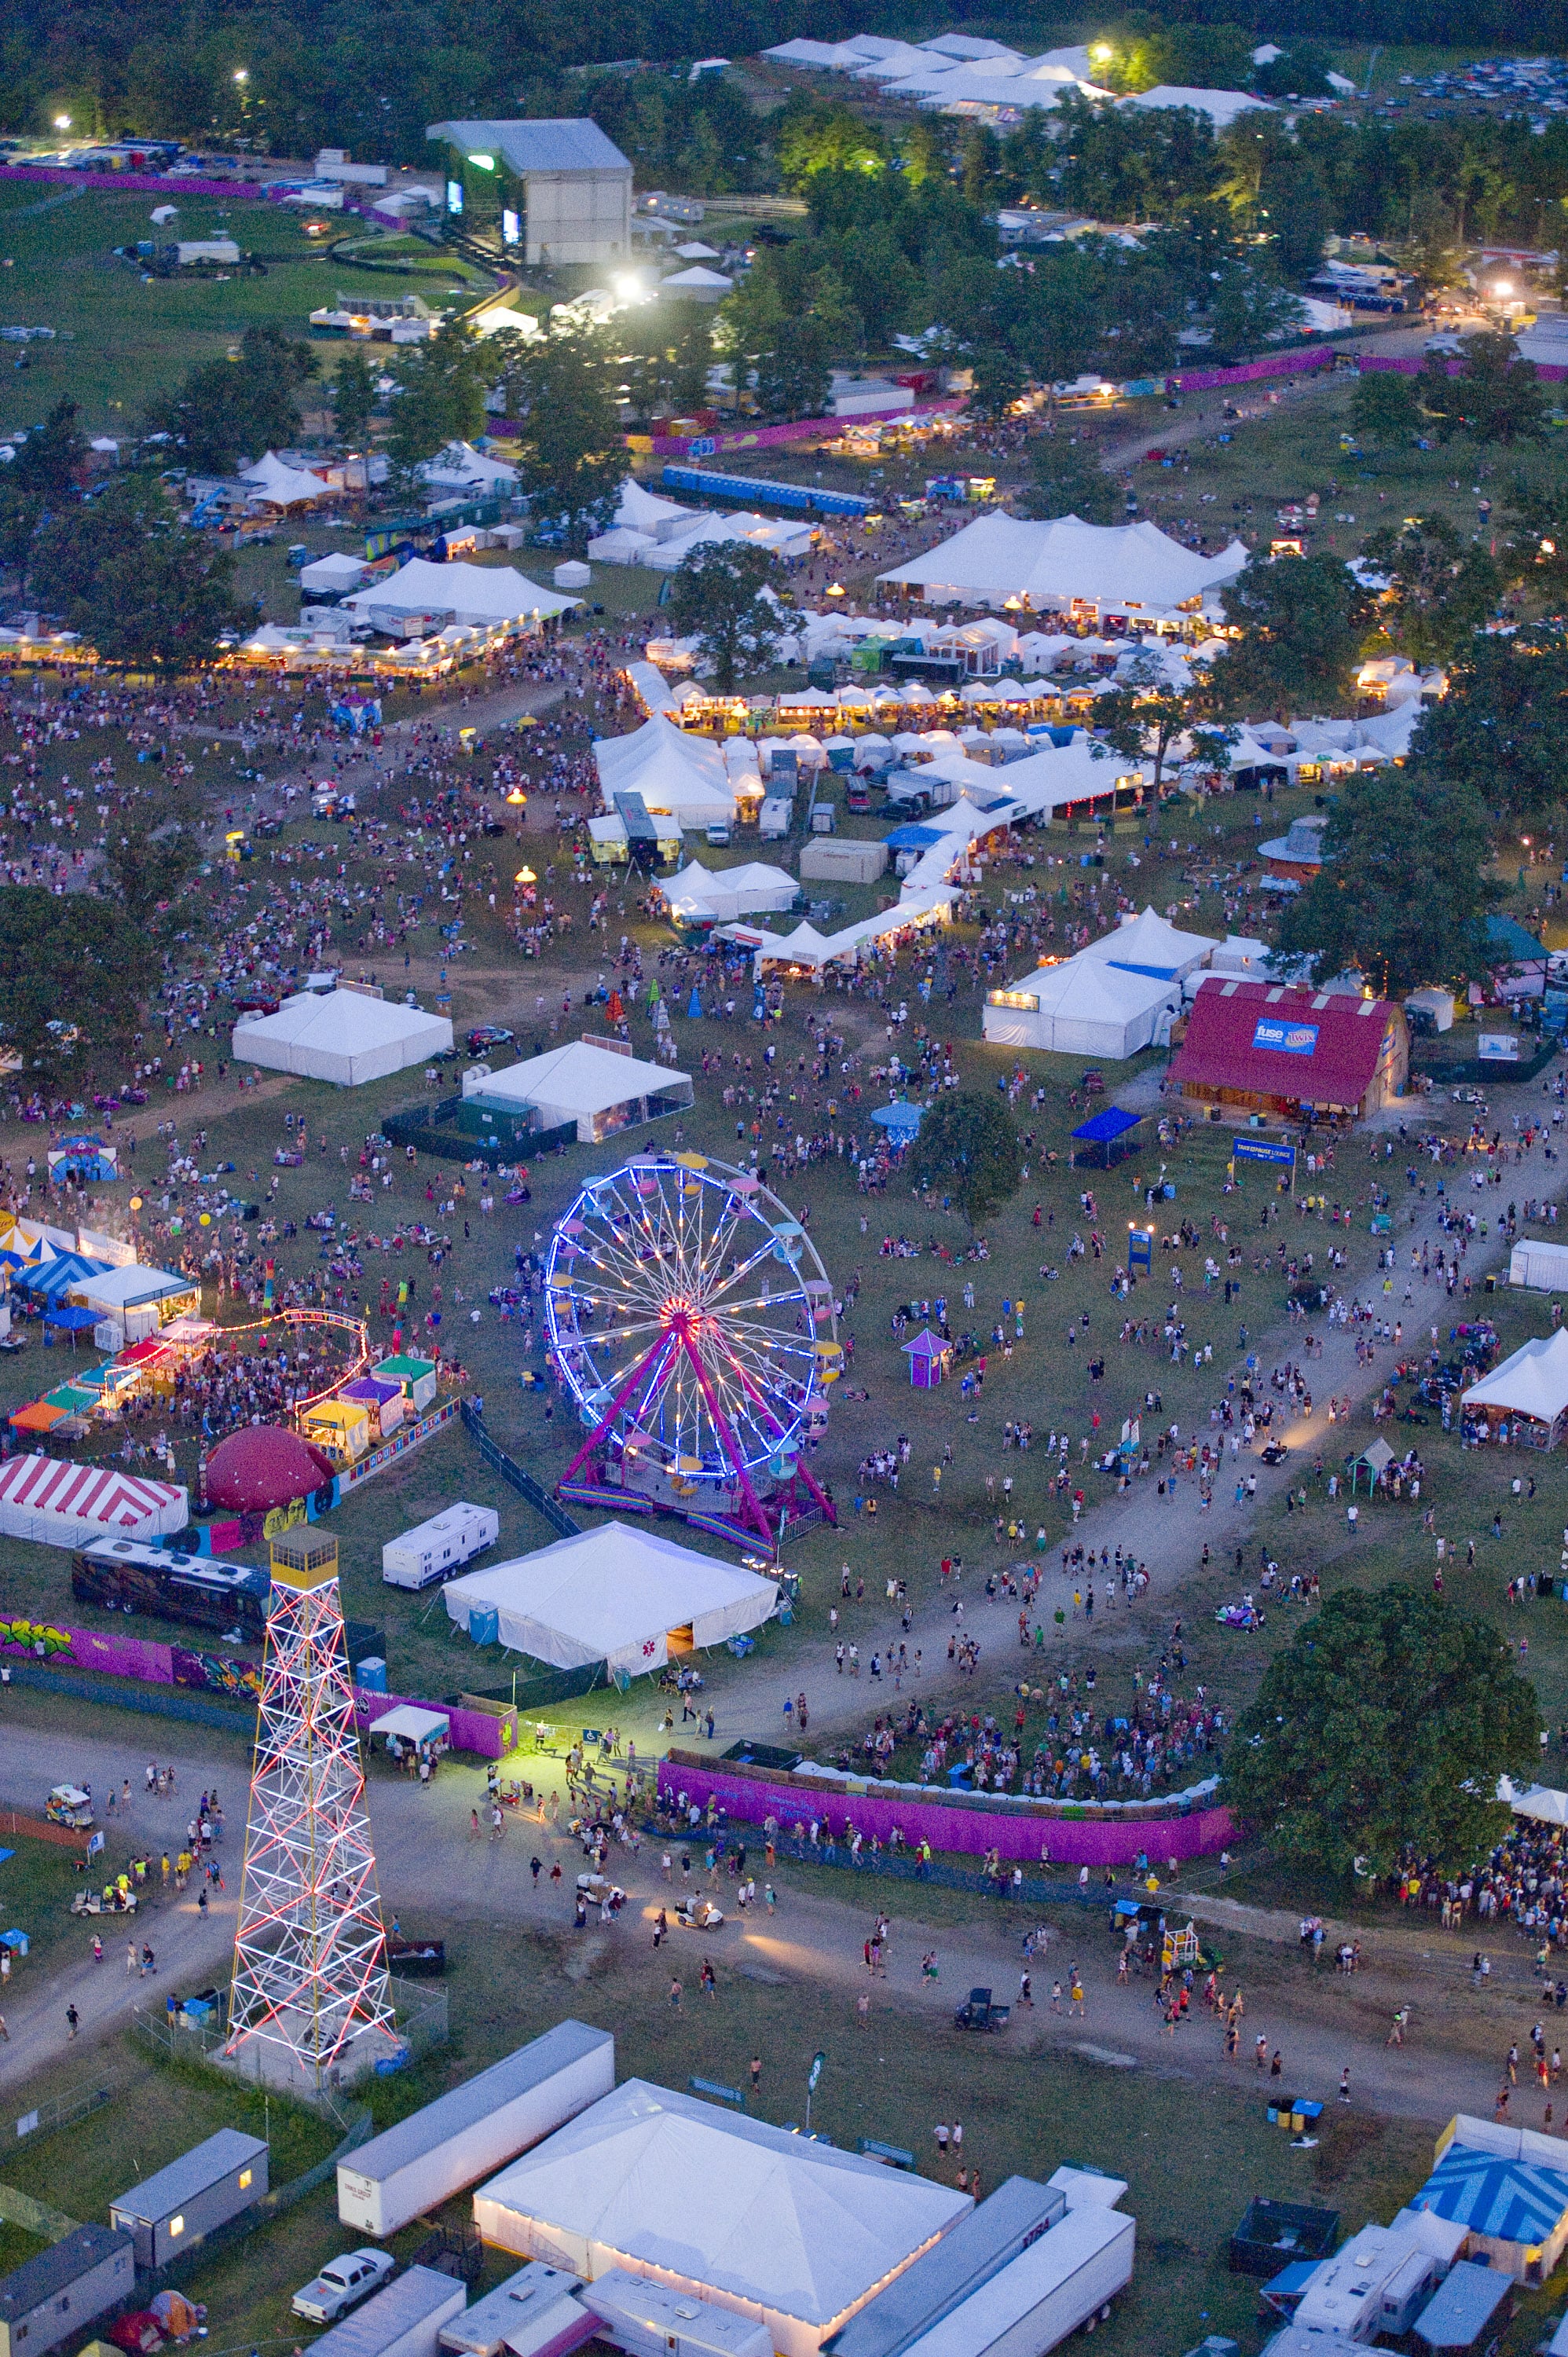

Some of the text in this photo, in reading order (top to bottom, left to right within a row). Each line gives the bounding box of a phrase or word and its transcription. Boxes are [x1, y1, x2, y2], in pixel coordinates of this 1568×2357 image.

[1257, 1025, 1284, 1039] fuse
[1288, 1032, 1316, 1043] Twix
[371, 1439, 402, 1466] ADULT
